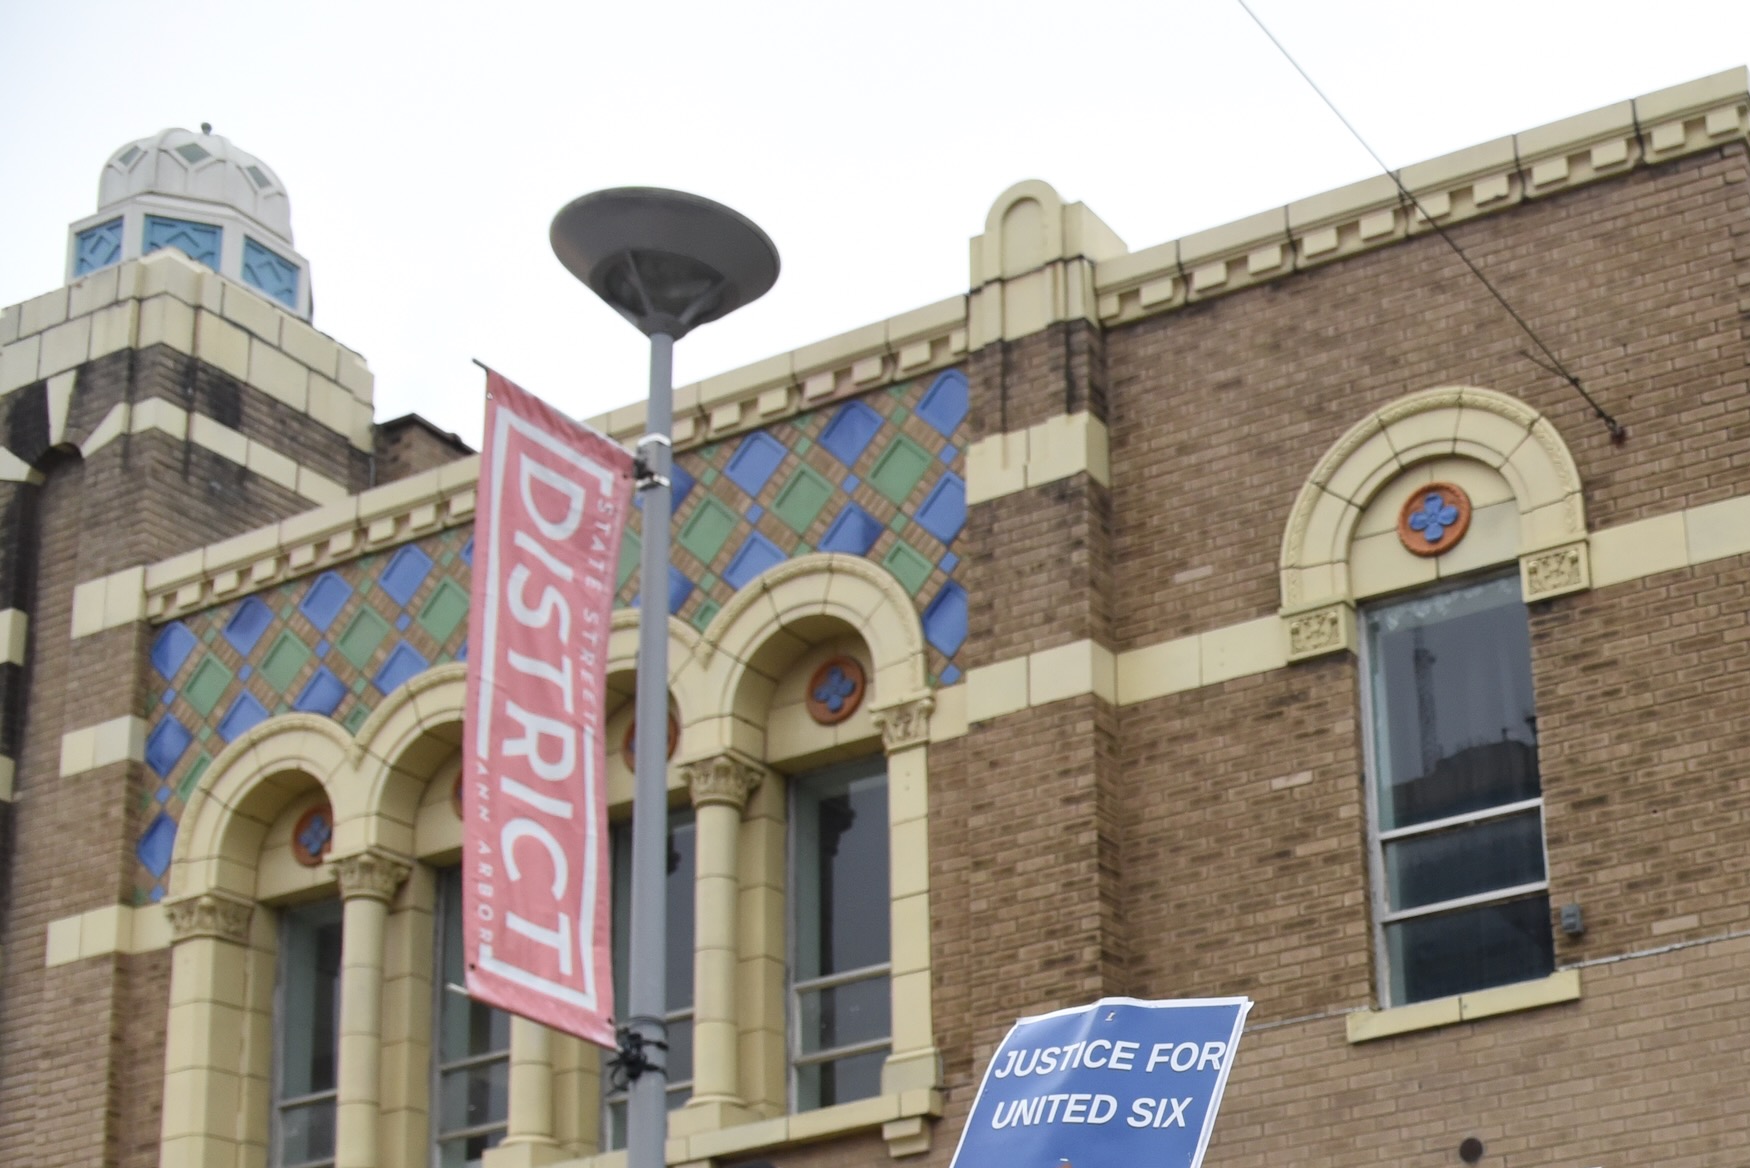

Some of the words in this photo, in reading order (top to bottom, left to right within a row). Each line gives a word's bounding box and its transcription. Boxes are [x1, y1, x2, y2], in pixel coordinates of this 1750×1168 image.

[590, 499, 614, 590] STATE
[580, 608, 602, 724] STREET
[499, 452, 587, 977] DISTRICT
[477, 762, 490, 821] ANN
[478, 840, 493, 943] ARBOR
[994, 1038, 1140, 1079] JUSTICE
[1146, 1040, 1226, 1073] FOR
[991, 1094, 1118, 1129] UNITED
[1126, 1096, 1193, 1128] SIX
